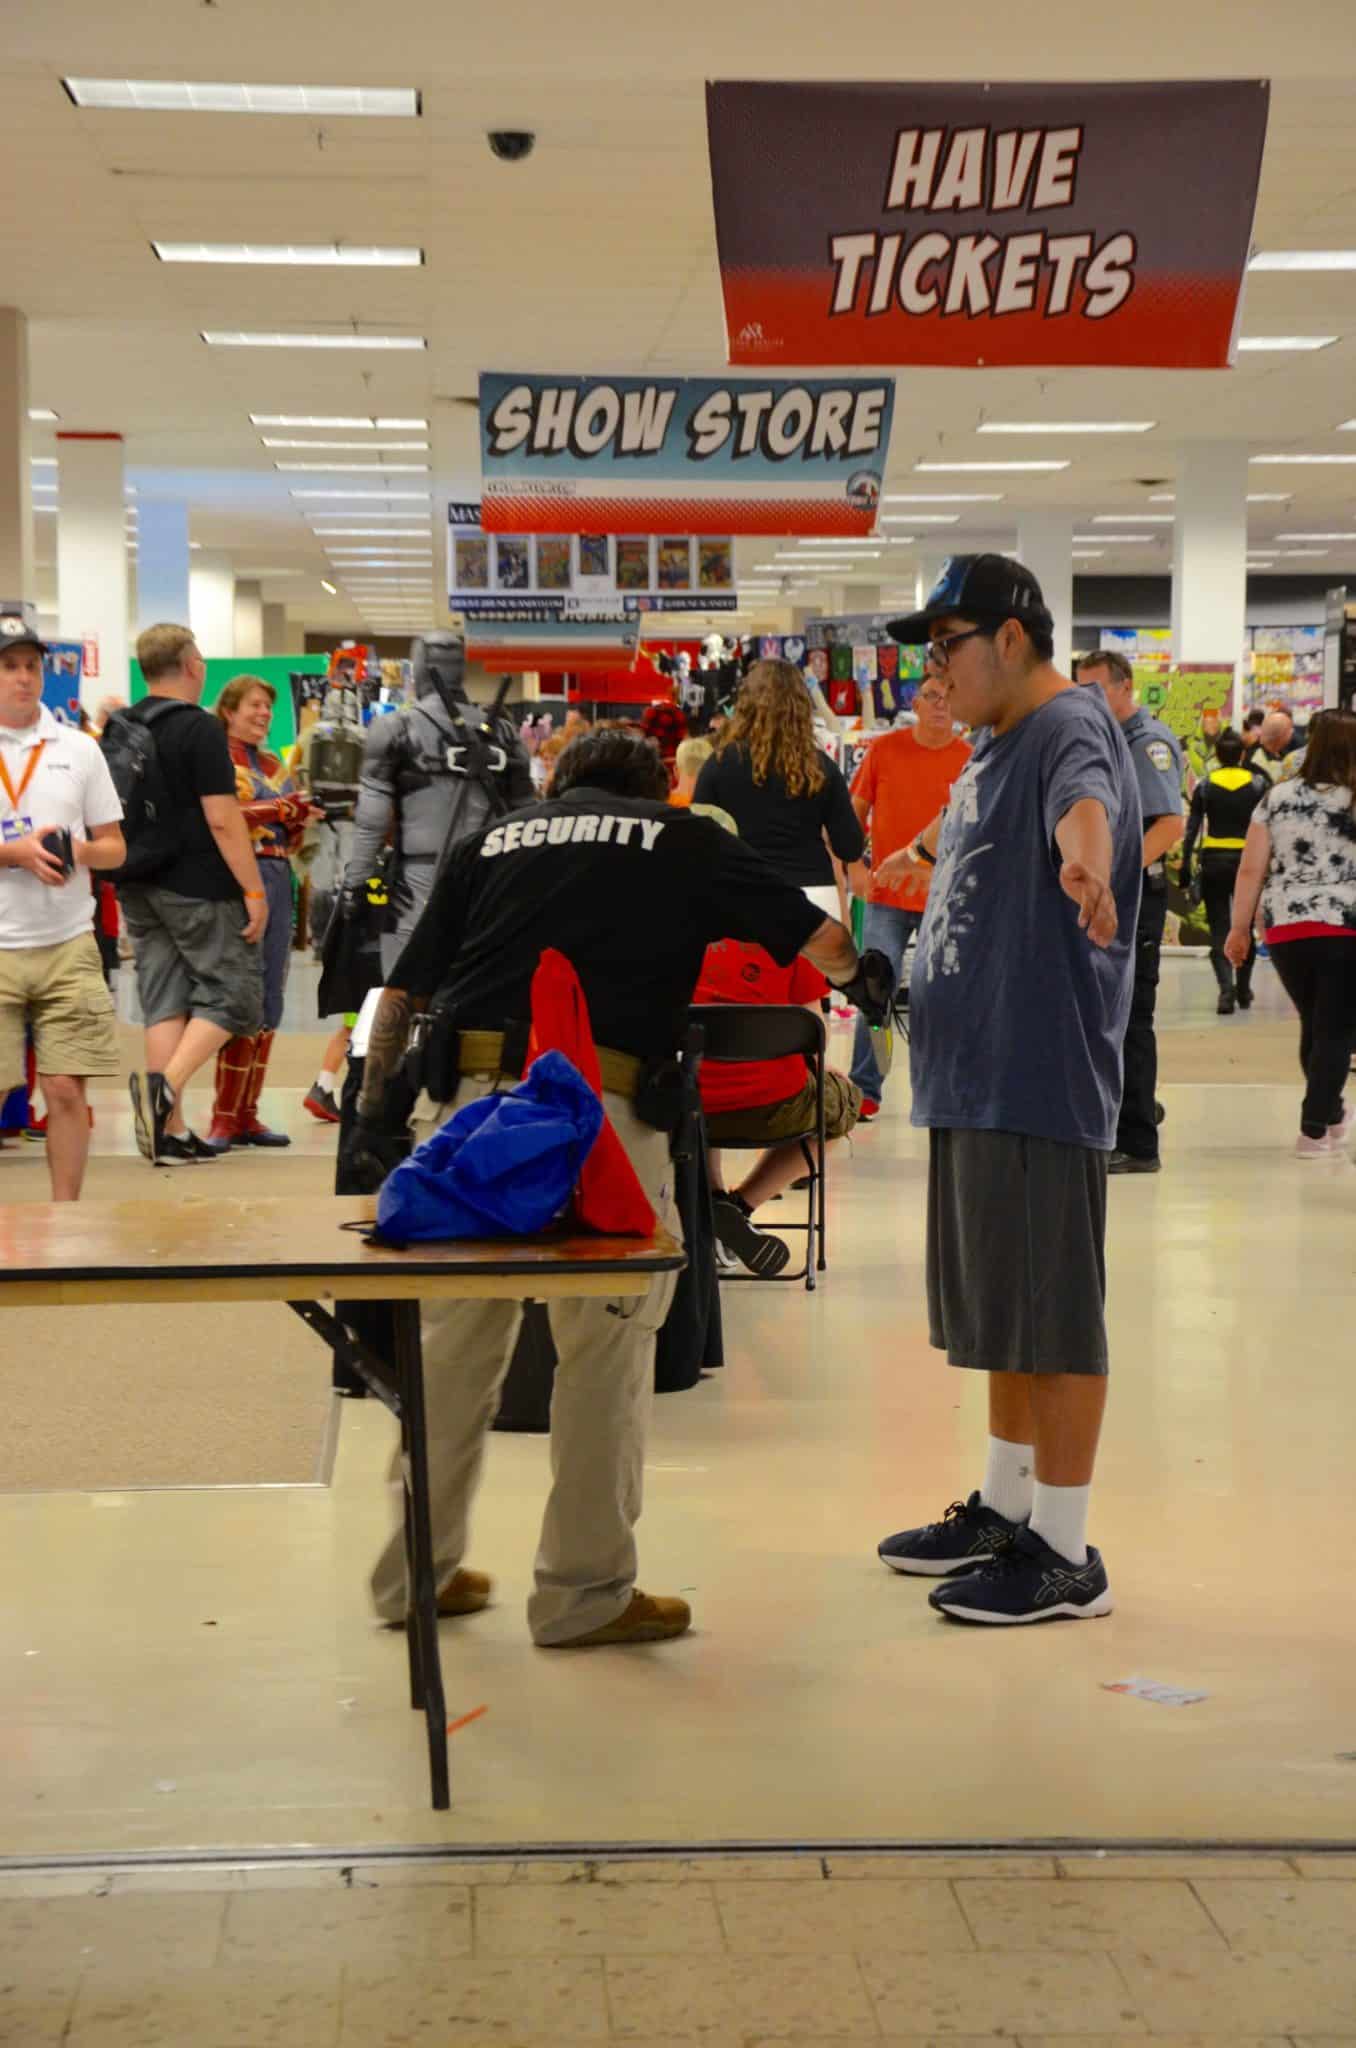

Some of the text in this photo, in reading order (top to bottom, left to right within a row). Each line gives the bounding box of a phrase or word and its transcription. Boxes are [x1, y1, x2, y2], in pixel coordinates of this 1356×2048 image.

[885, 125, 1083, 213] HAVE
[828, 230, 1137, 319] TICKETS
[487, 383, 886, 461] SHOW STORE
[479, 814, 666, 858] SECURITY
